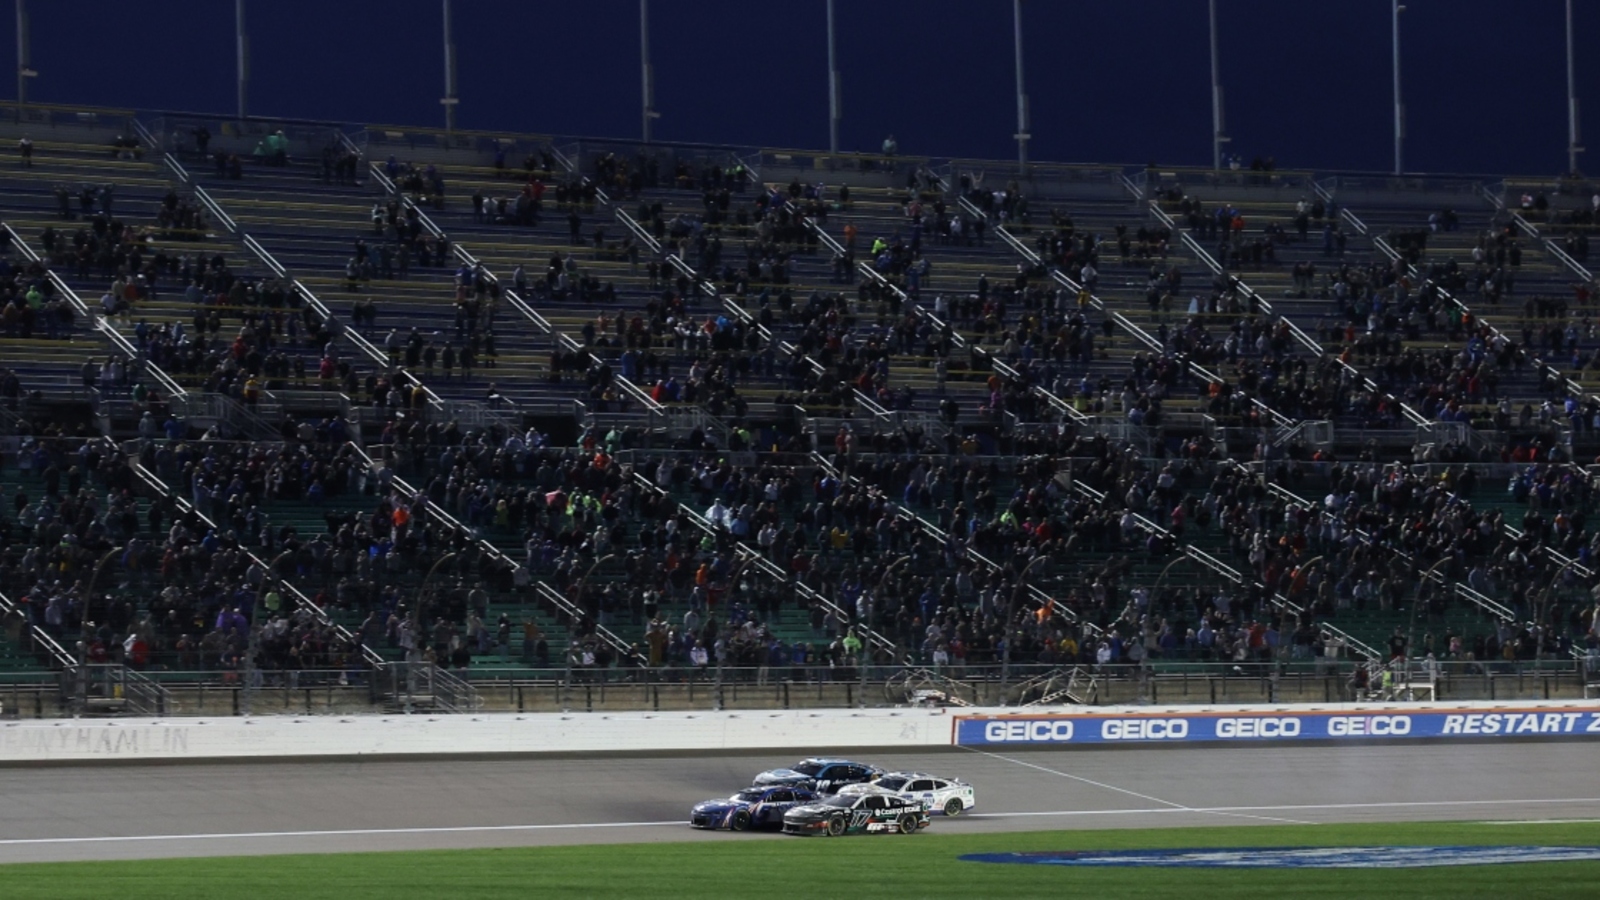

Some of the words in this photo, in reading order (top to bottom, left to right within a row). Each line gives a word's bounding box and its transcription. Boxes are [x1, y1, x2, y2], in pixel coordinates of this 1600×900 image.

[985, 720, 1074, 742] GEICO
[1101, 718, 1189, 740] GEICO
[1215, 717, 1302, 739] GEICO
[1327, 715, 1412, 737] GEICO
[1442, 713, 1583, 734] RESTART
[850, 809, 873, 827] 17
